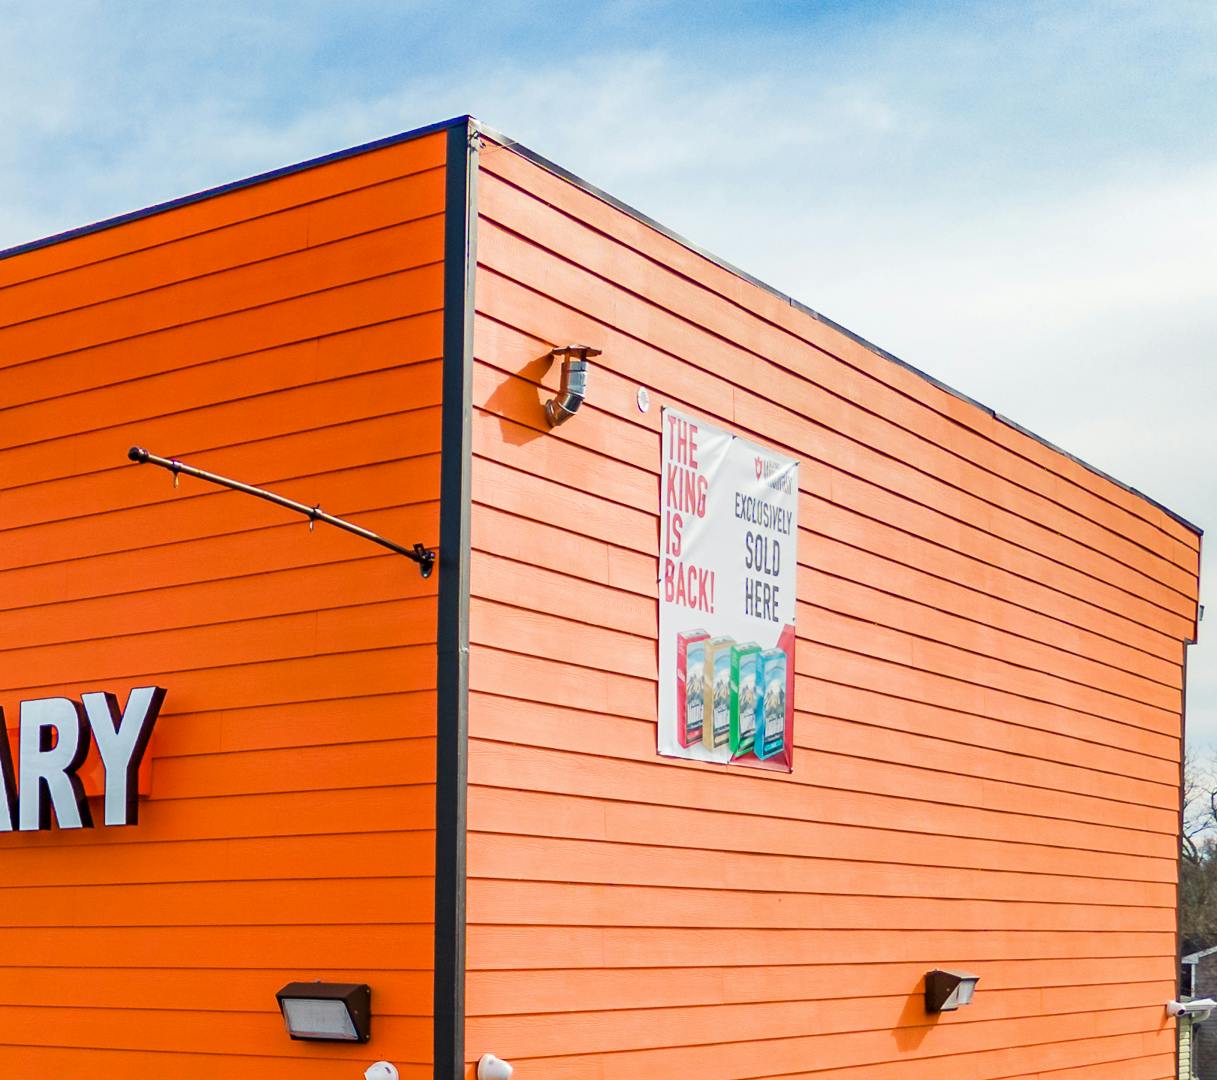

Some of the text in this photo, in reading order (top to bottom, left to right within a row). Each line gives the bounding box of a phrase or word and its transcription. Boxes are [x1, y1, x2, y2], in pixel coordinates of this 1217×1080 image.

[667, 414, 698, 469] THE
[666, 462, 708, 518] KING
[665, 512, 683, 557] IS
[734, 492, 792, 536] EXCLUSIVELY
[745, 530, 780, 577] SOLD
[664, 557, 715, 614] BACK!
[745, 576, 779, 623] HERE
